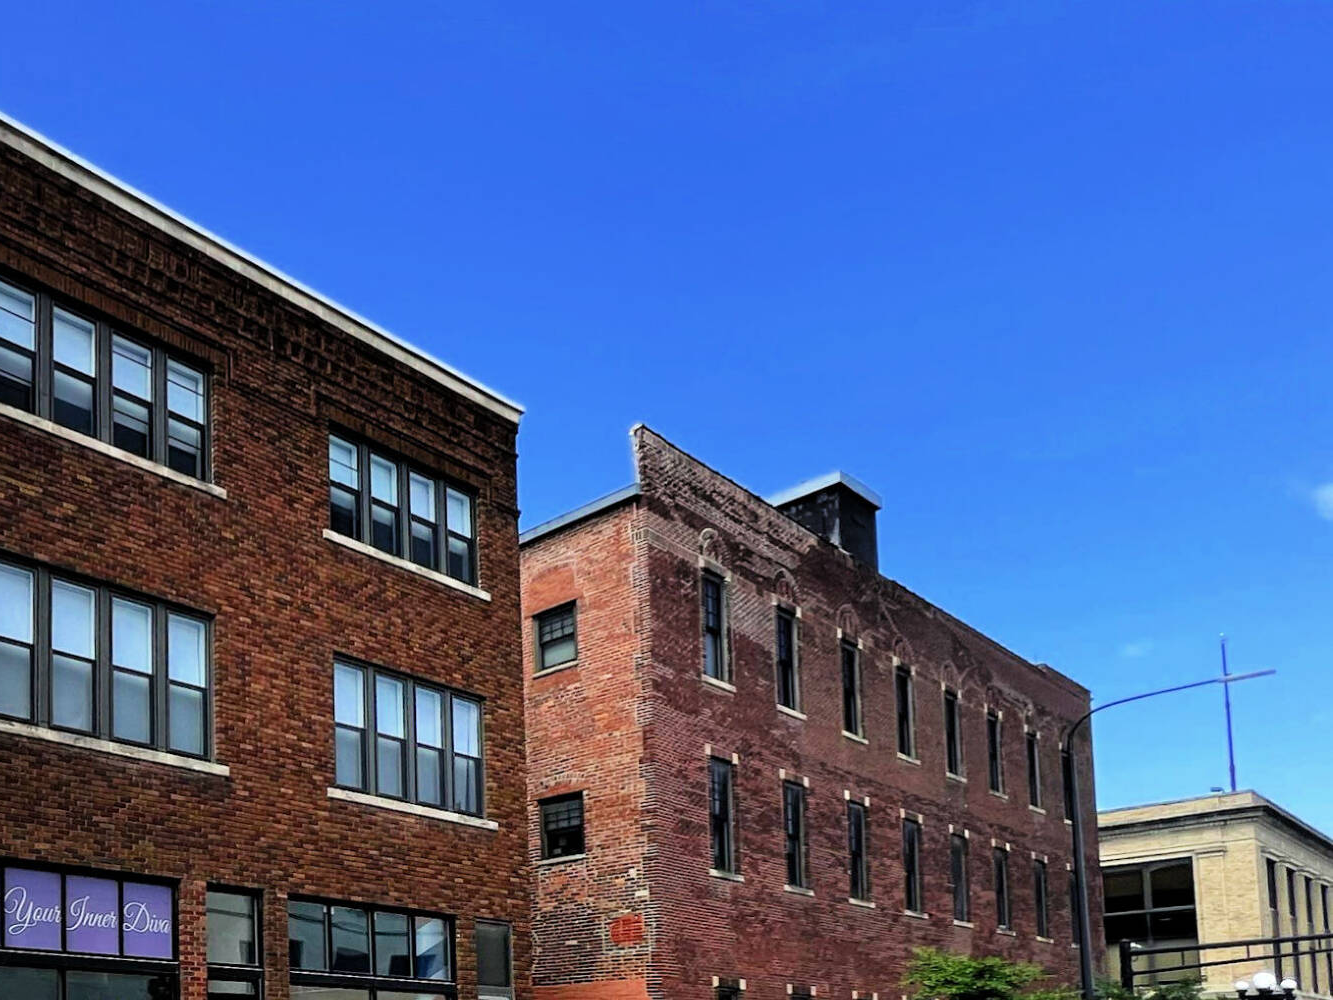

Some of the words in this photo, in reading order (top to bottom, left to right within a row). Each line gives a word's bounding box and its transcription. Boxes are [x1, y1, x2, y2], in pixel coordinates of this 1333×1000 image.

[4, 886, 62, 935] Your
[66, 895, 118, 931] Inner
[123, 902, 171, 933] Diva
